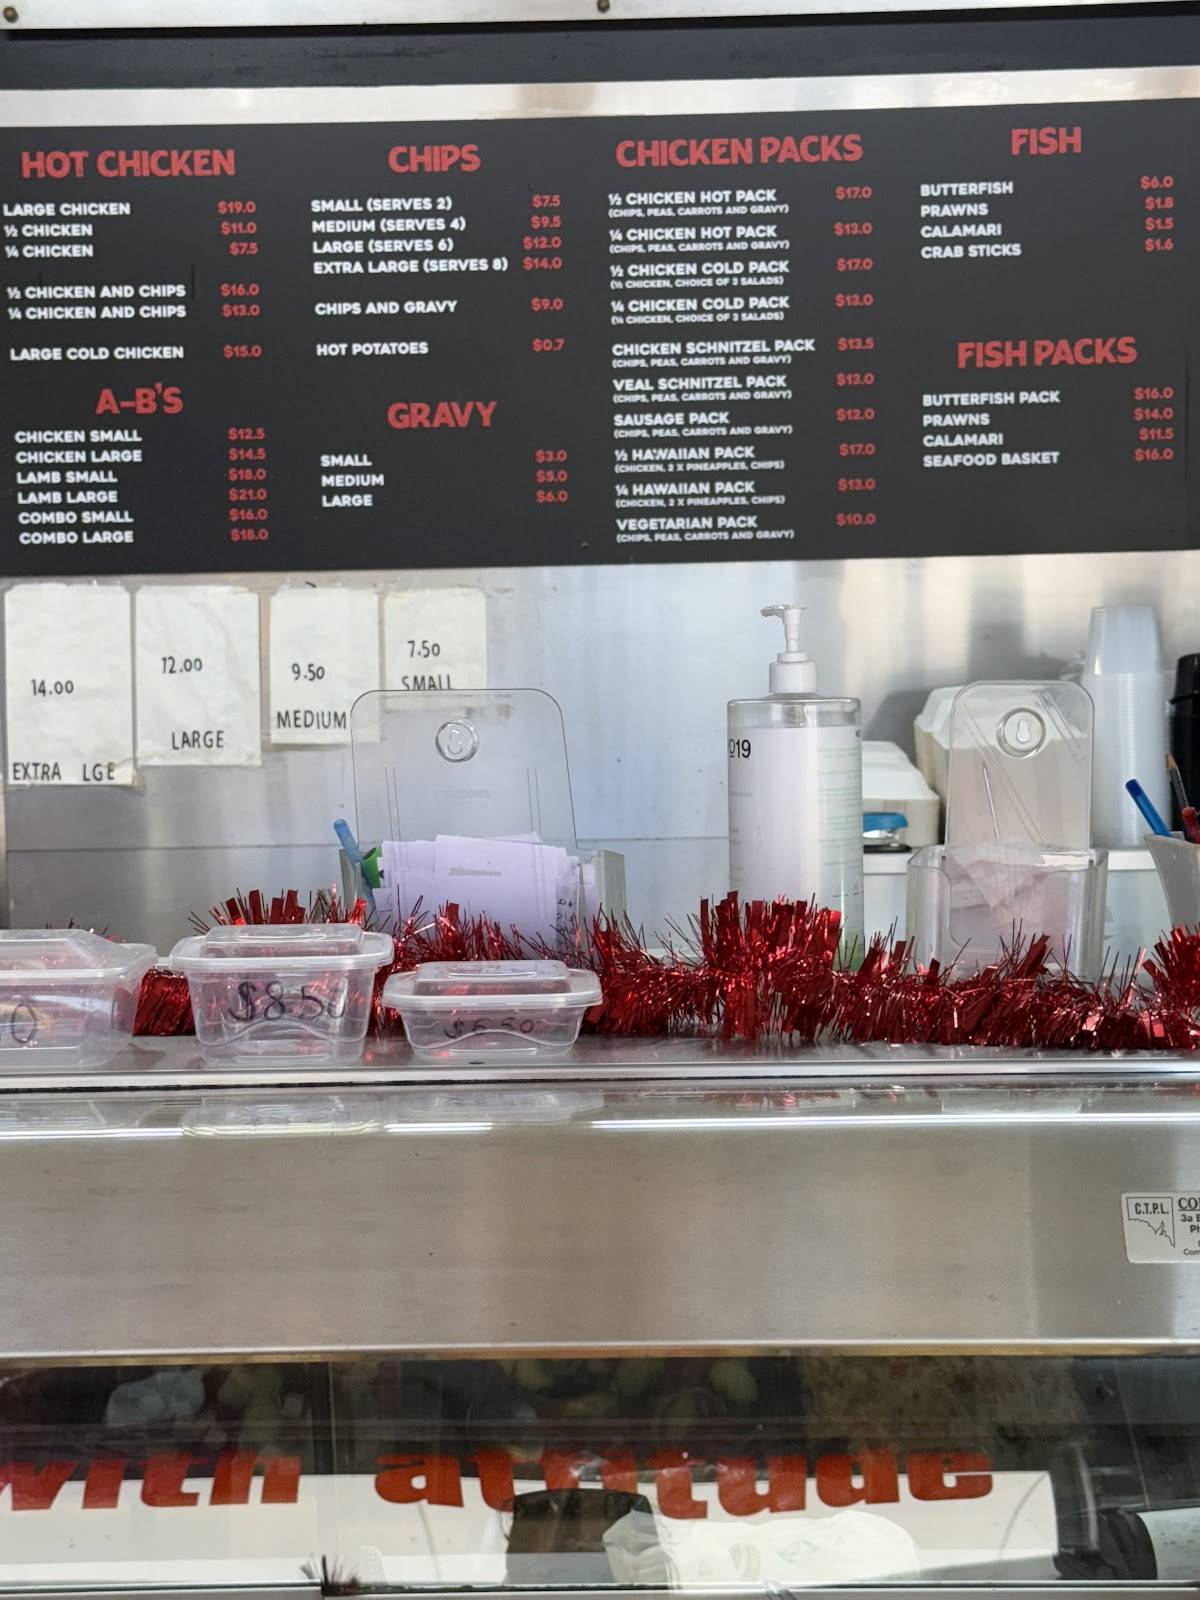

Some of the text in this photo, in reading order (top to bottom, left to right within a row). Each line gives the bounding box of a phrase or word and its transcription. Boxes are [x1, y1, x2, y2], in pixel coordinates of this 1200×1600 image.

[615, 134, 863, 167] CHICKEN PACKS
[1010, 128, 1081, 156] FISH
[21, 150, 235, 179] HOT CHICKEN
[388, 144, 480, 173] CHIPS
[920, 176, 1174, 196] BUTTERFISH $6.0
[311, 195, 560, 212] SMALL (SERVES 2) $7.5
[626, 187, 872, 205] CHICKEN HOT PACK $17.0
[3, 201, 256, 216] LARGE CHICKEN $19.0
[921, 197, 1174, 217] PRAWNS $1.8
[22, 223, 256, 237] CHICKEN $11.0
[312, 216, 560, 232] MEDIUM (SERVES 4) $9.5
[626, 223, 871, 241] CHICKEN HOT PACK $13.0
[920, 217, 1174, 238] CALAMARI $1.5
[22, 242, 257, 257] CHICKEN $7.5
[313, 236, 560, 253] LARGE (SERVES 6) $12.0
[921, 239, 1172, 259] CRAB STICKS $1.6
[314, 256, 561, 274] EXTRA LARGE (SERVES 8) $14.0
[627, 258, 873, 276] CHICKEN COLD PACK $17.0
[25, 283, 260, 299] CHICKEN AND CHIPS $16.0
[25, 304, 260, 319] CHICKEN AND CHIPS $13.0
[315, 297, 564, 315] CHIPS AND GRAVY $9.0
[628, 293, 873, 312] CHICKEN COLD PACK $13.0
[10, 346, 261, 360] LARGE COLD CHICKEN $15.0
[317, 338, 564, 356] HOT POTATOES $0.7
[612, 337, 875, 356] CHICKEN SCHNITZEL PACK $13.5
[957, 336, 1136, 368] FISH PACKS
[613, 373, 874, 391] VEAL SCHNITZEL PACK $13.0
[923, 387, 1174, 406] BUTTERFISH PACK $16.0
[387, 400, 496, 430] GRAVY
[614, 408, 875, 426] SAUSAGE PACK $12.0
[923, 406, 1173, 426] PRAWNS $14.0
[15, 428, 265, 443] CHICKEN SMALL $12.5
[923, 428, 1173, 447] CALAMARI $11.5
[16, 448, 265, 464] CHICKEN LARGE $14.5
[320, 450, 567, 467] SMALL $3.0
[632, 443, 876, 460] HAWAIIAN PACK $17.0
[923, 448, 1174, 467] SEAFOOD BASKET $16.0
[17, 469, 265, 484] LAMB SMALL $18.0
[321, 470, 568, 487] MEDIUM $5.0
[18, 488, 267, 504] LAMB LARGE $21.0
[633, 480, 876, 495] HAWAIIAN PACK $13.0
[322, 490, 567, 507] LARGE $6.0
[18, 508, 267, 524] COMBO SMALL $16.0
[616, 513, 876, 530] VEGETARIAN PACK $10.0
[19, 528, 268, 544] COMBO LARGE $18.0
[407, 639, 441, 659] 7.50
[161, 656, 203, 674] 12.00
[291, 662, 326, 682] 9.50
[31, 678, 75, 697] 14.00
[276, 709, 347, 730] MEDIUM
[171, 729, 225, 751] LARGE
[12, 761, 116, 782] EXTRA LGE
[1134, 1202, 1170, 1215] C.T.P.L.
